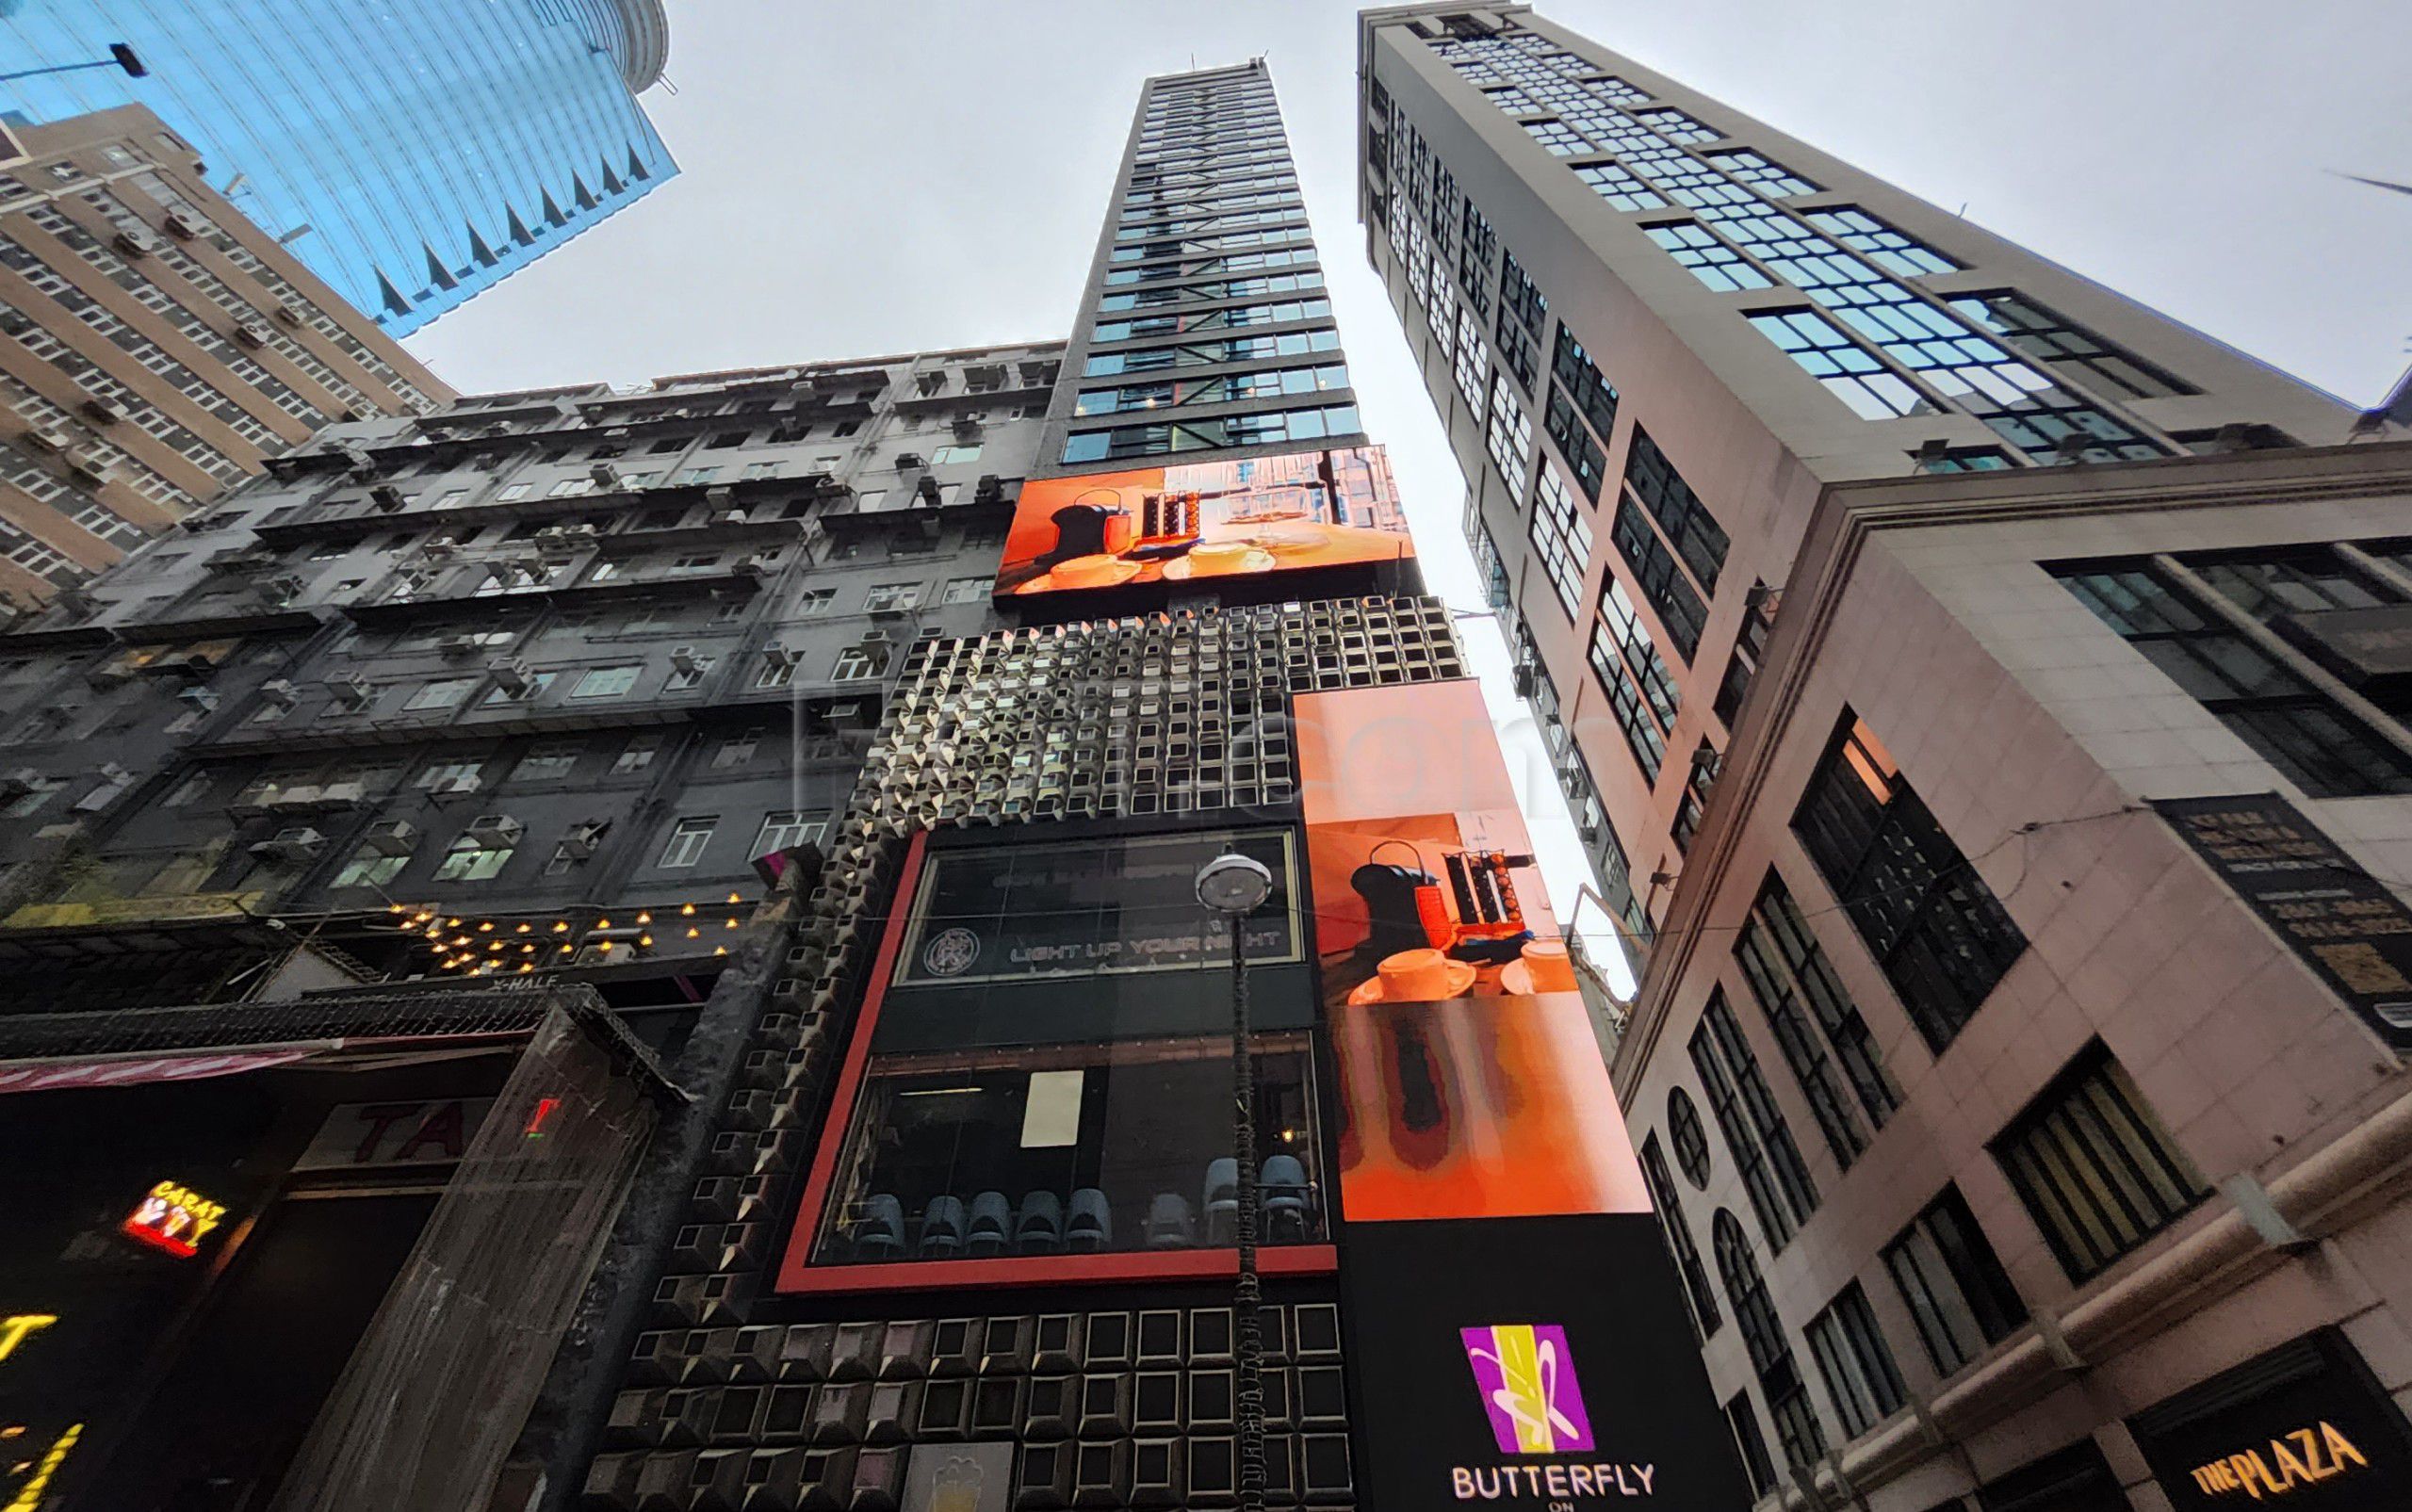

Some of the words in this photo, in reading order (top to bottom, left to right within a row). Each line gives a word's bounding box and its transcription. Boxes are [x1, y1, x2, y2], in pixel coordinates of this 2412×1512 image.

[1010, 945, 1081, 962] LIGHT
[1086, 942, 1122, 957] UP
[1129, 936, 1201, 953] YOUR
[1205, 932, 1280, 950] NIHT
[2229, 1421, 2368, 1501] PLAZA
[1452, 1463, 1654, 1500] BUTTERFLY
